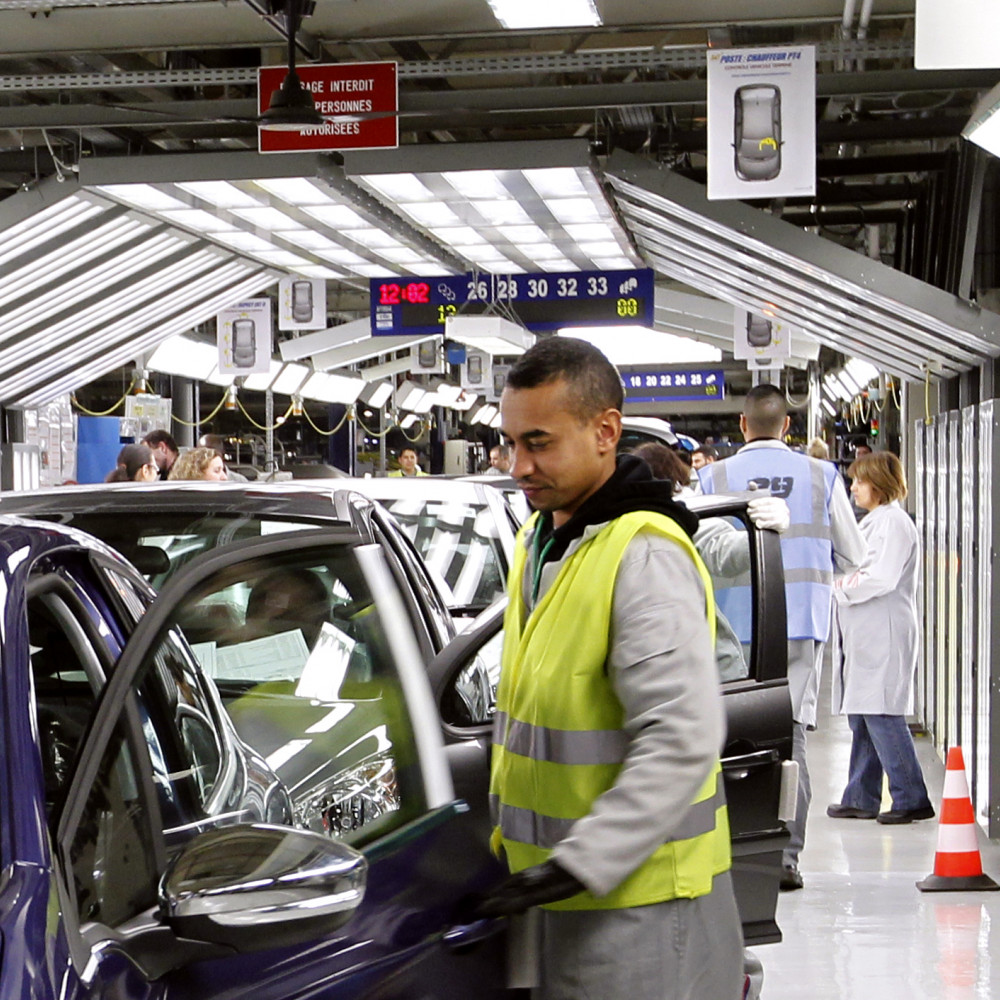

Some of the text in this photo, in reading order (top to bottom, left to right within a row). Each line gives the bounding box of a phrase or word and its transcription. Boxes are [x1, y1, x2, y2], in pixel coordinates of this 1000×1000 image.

[330, 79, 374, 92] INTERDIT
[315, 99, 372, 113] PERSONNES
[379, 282, 430, 305] 12:02
[467, 277, 608, 300] 26 28 30 32 33
[646, 375, 657, 387] 20
